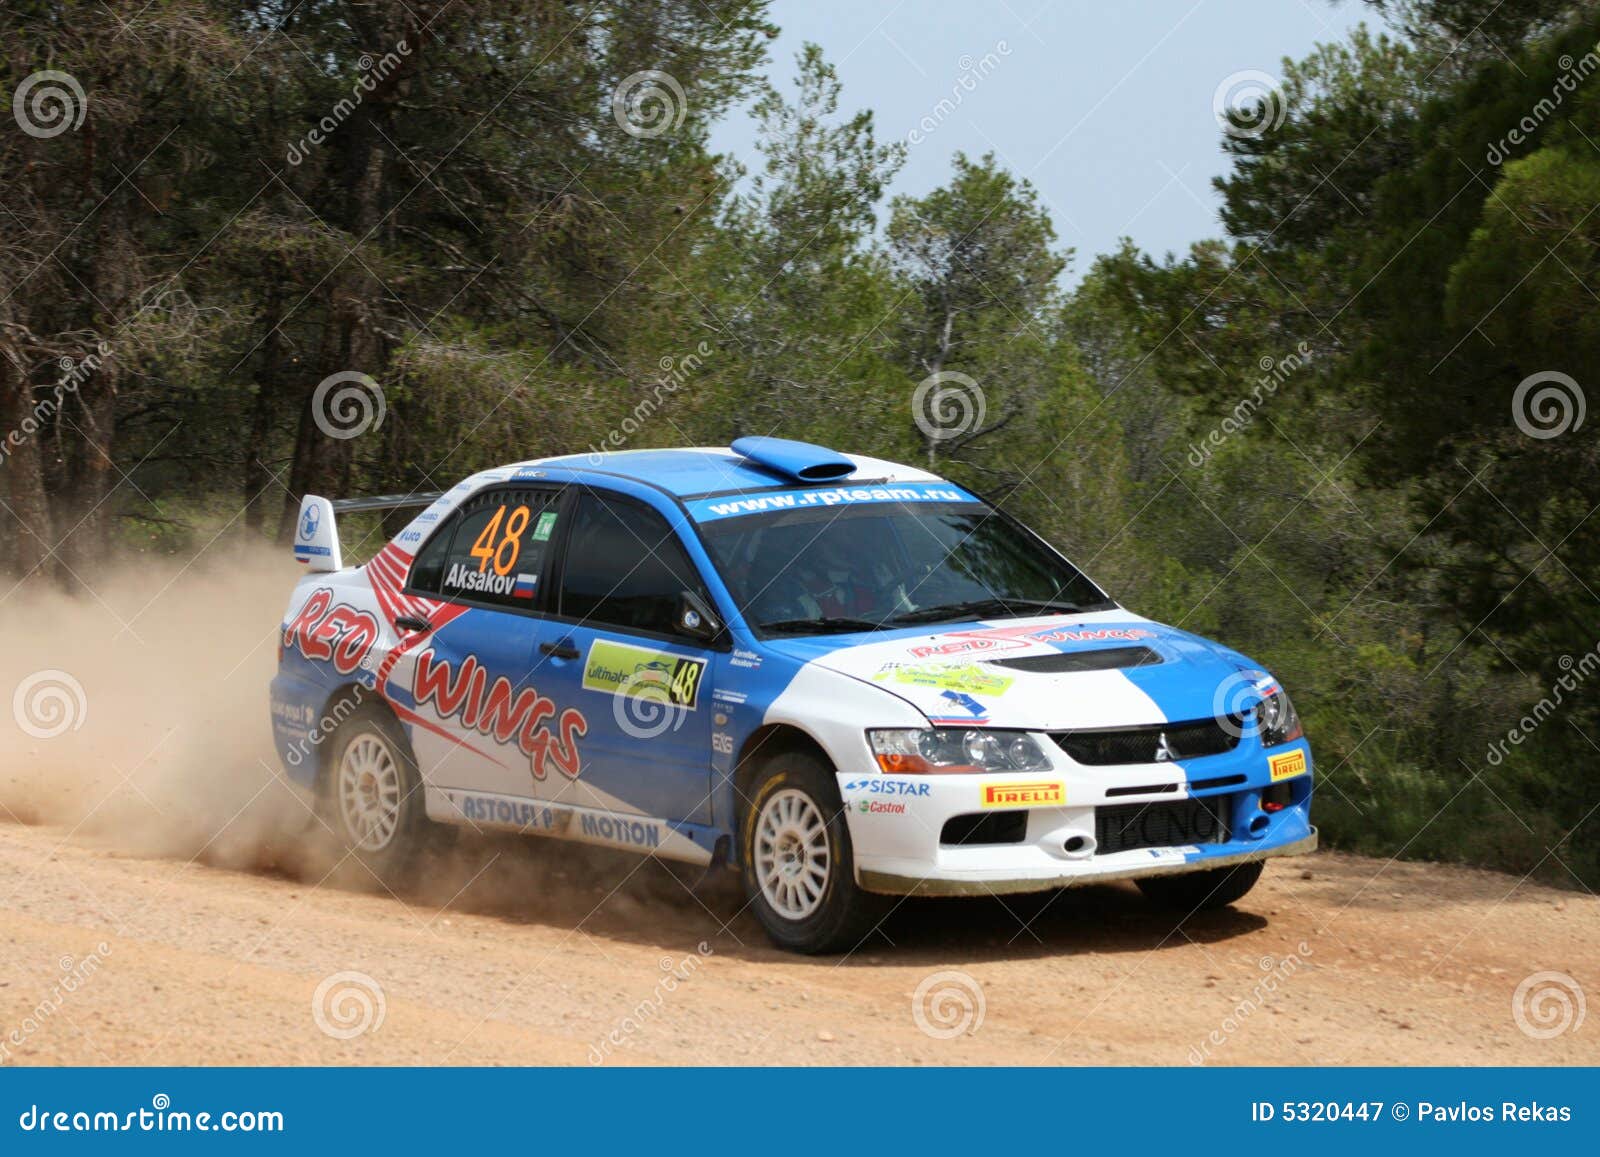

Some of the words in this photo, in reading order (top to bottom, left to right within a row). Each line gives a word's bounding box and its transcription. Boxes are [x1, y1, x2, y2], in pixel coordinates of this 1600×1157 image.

[707, 487, 962, 516] www.rpteam.ru
[470, 504, 531, 576] 48
[445, 564, 517, 595] Aksakov
[284, 588, 380, 675] RED
[908, 639, 997, 658] RED
[588, 664, 632, 685] ultimate
[672, 661, 699, 704] 48
[412, 648, 587, 782] WINGS
[1272, 753, 1304, 776] PIRELLI
[870, 779, 931, 797] SISTAR
[986, 783, 1060, 803] PIRELLI
[464, 796, 537, 829] ASTOLFI
[870, 801, 906, 814] Castrol
